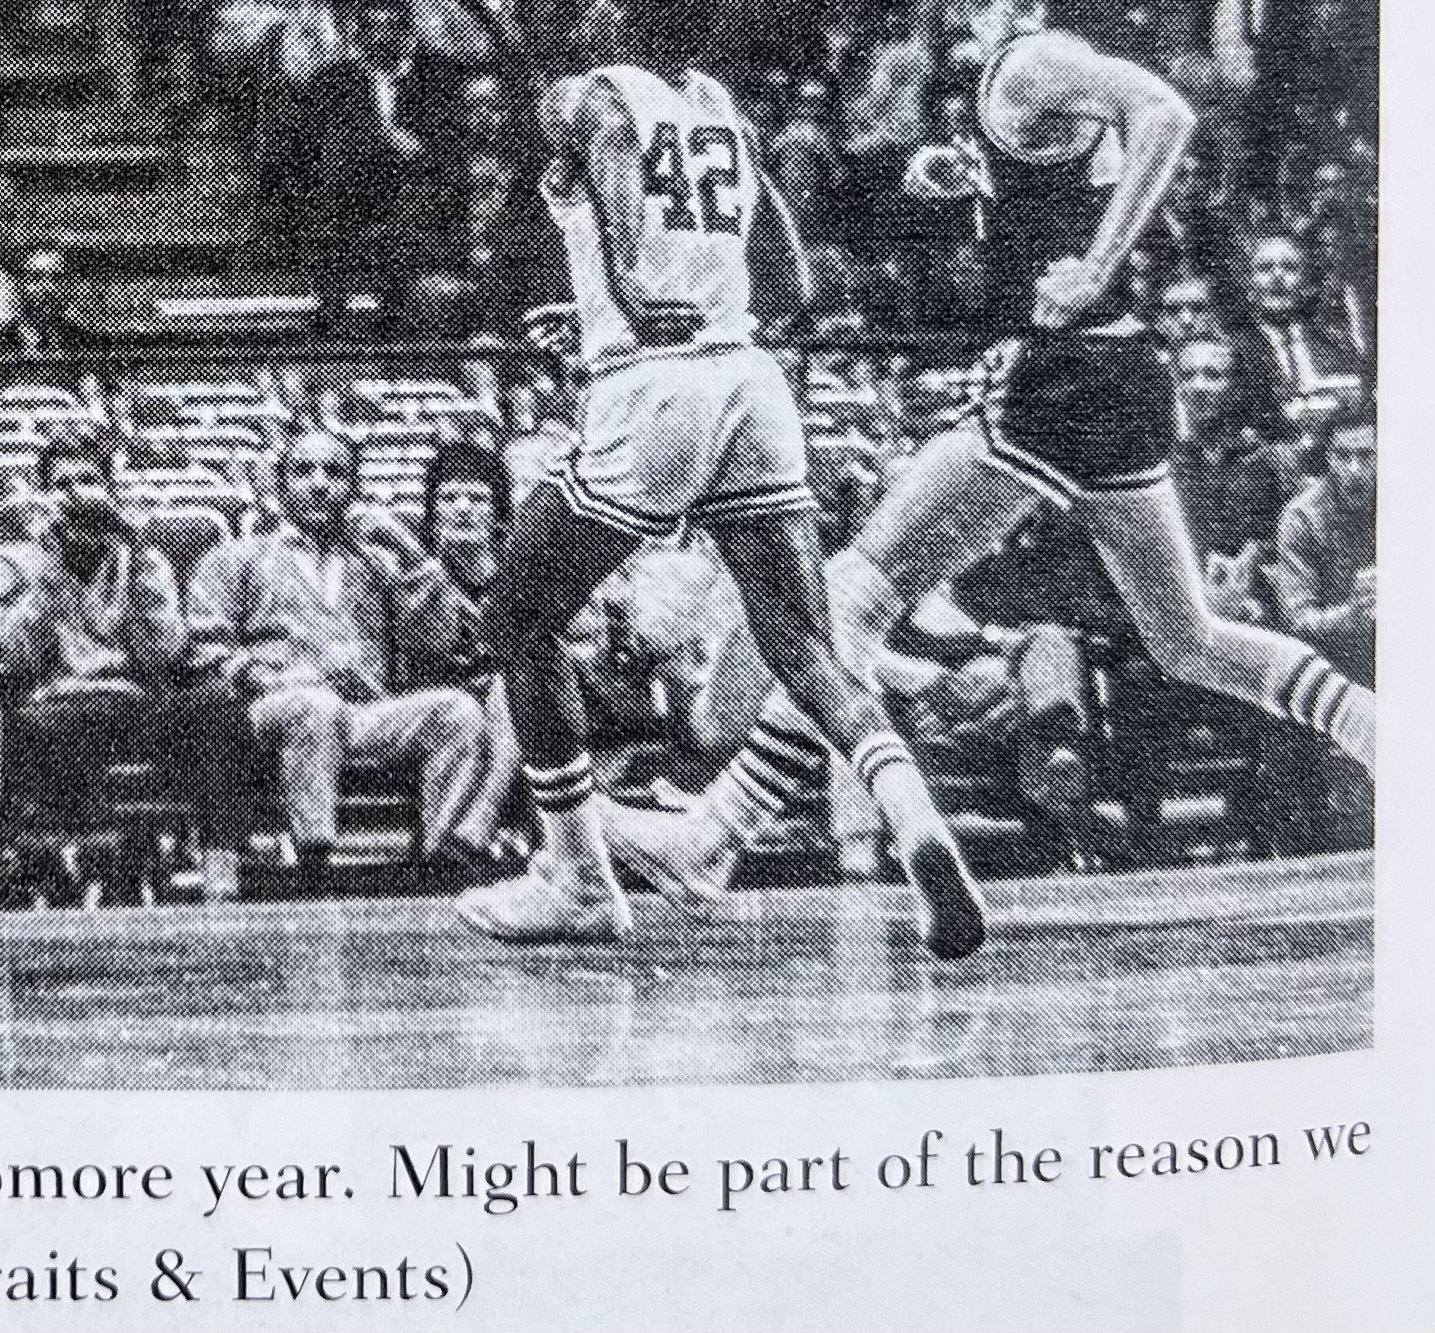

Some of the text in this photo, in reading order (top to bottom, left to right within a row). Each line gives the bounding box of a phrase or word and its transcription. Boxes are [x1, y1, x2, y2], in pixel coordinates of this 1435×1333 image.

[640, 120, 744, 237] 42
[198, 1162, 356, 1221] year.
[386, 1137, 590, 1219] Might
[613, 1135, 692, 1199] be
[715, 1144, 853, 1214] part
[876, 1127, 946, 1192] of
[964, 1125, 1065, 1189] the
[1087, 1131, 1284, 1182] reason
[1301, 1119, 1373, 1164] we
[149, 1246, 205, 1305] &
[231, 1239, 476, 1314] Events)
